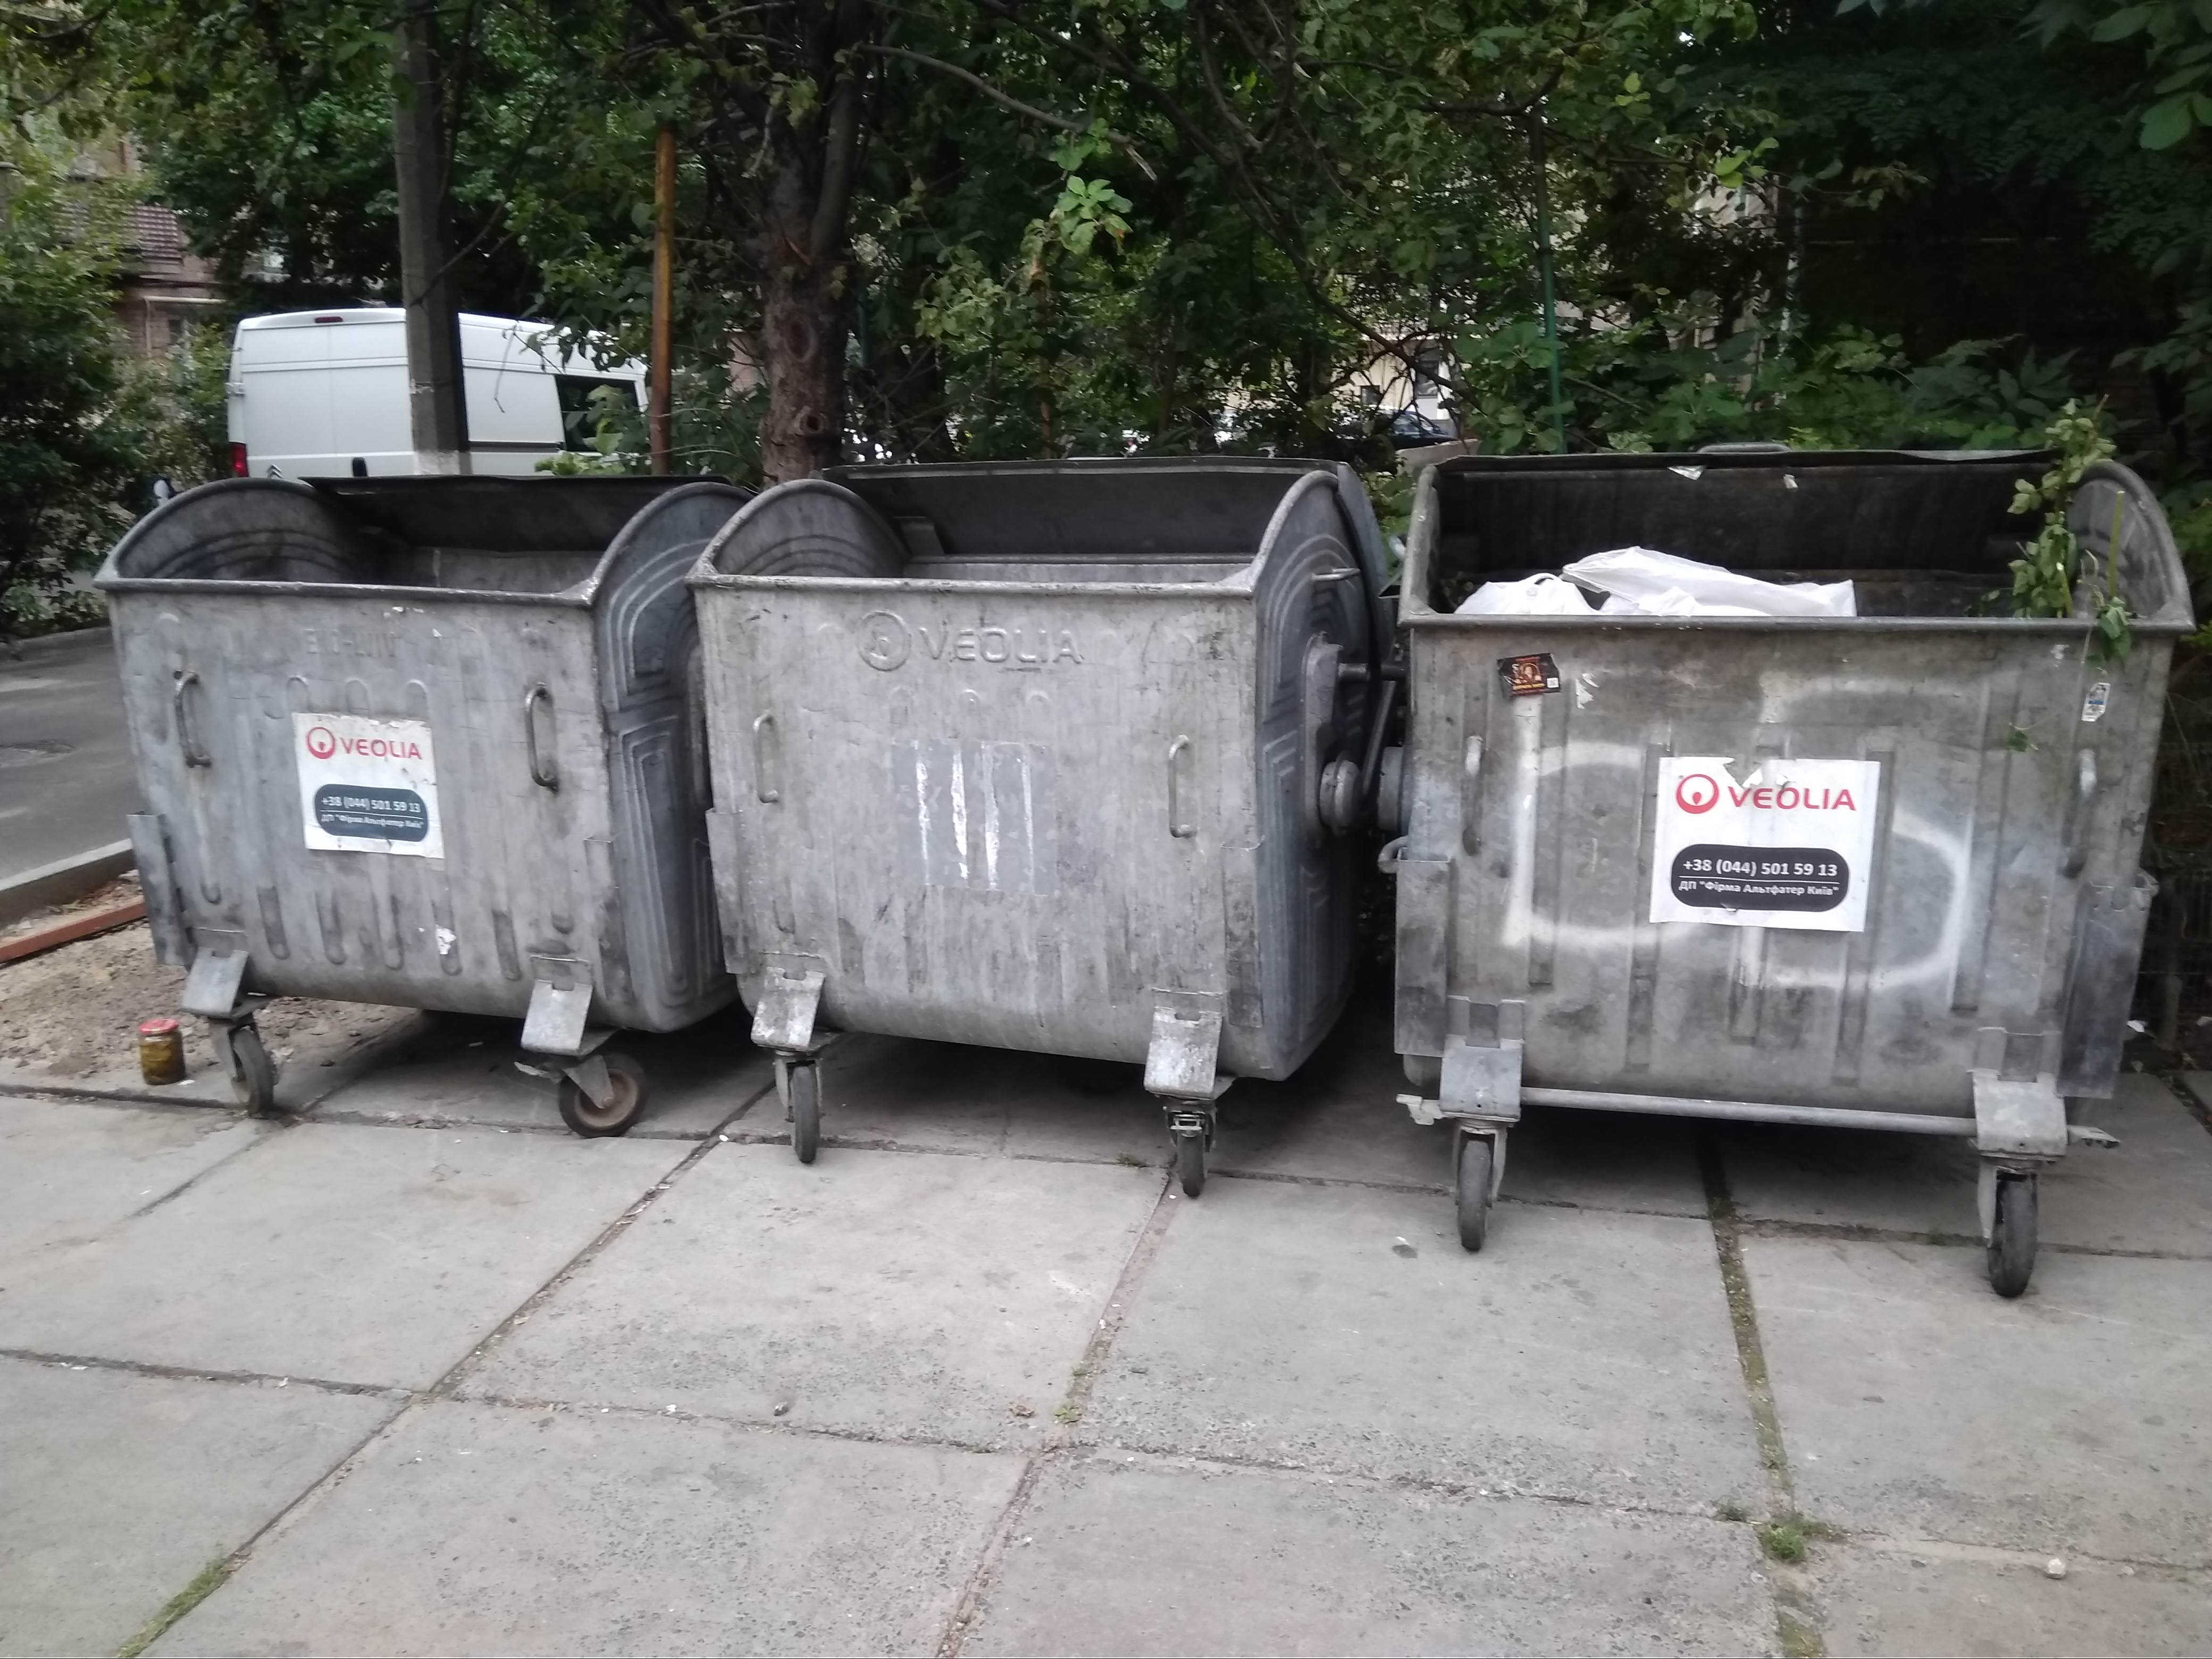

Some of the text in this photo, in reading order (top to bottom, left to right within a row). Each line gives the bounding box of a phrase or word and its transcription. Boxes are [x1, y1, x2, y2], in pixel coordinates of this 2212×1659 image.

[919, 626, 1083, 664] VEOLIA
[340, 737, 422, 760] VEOLIA
[1728, 785, 1856, 811] VEOLIA
[1683, 859, 1838, 877] +38 (044) 501 59 13
[1678, 881, 1697, 891] ДП
